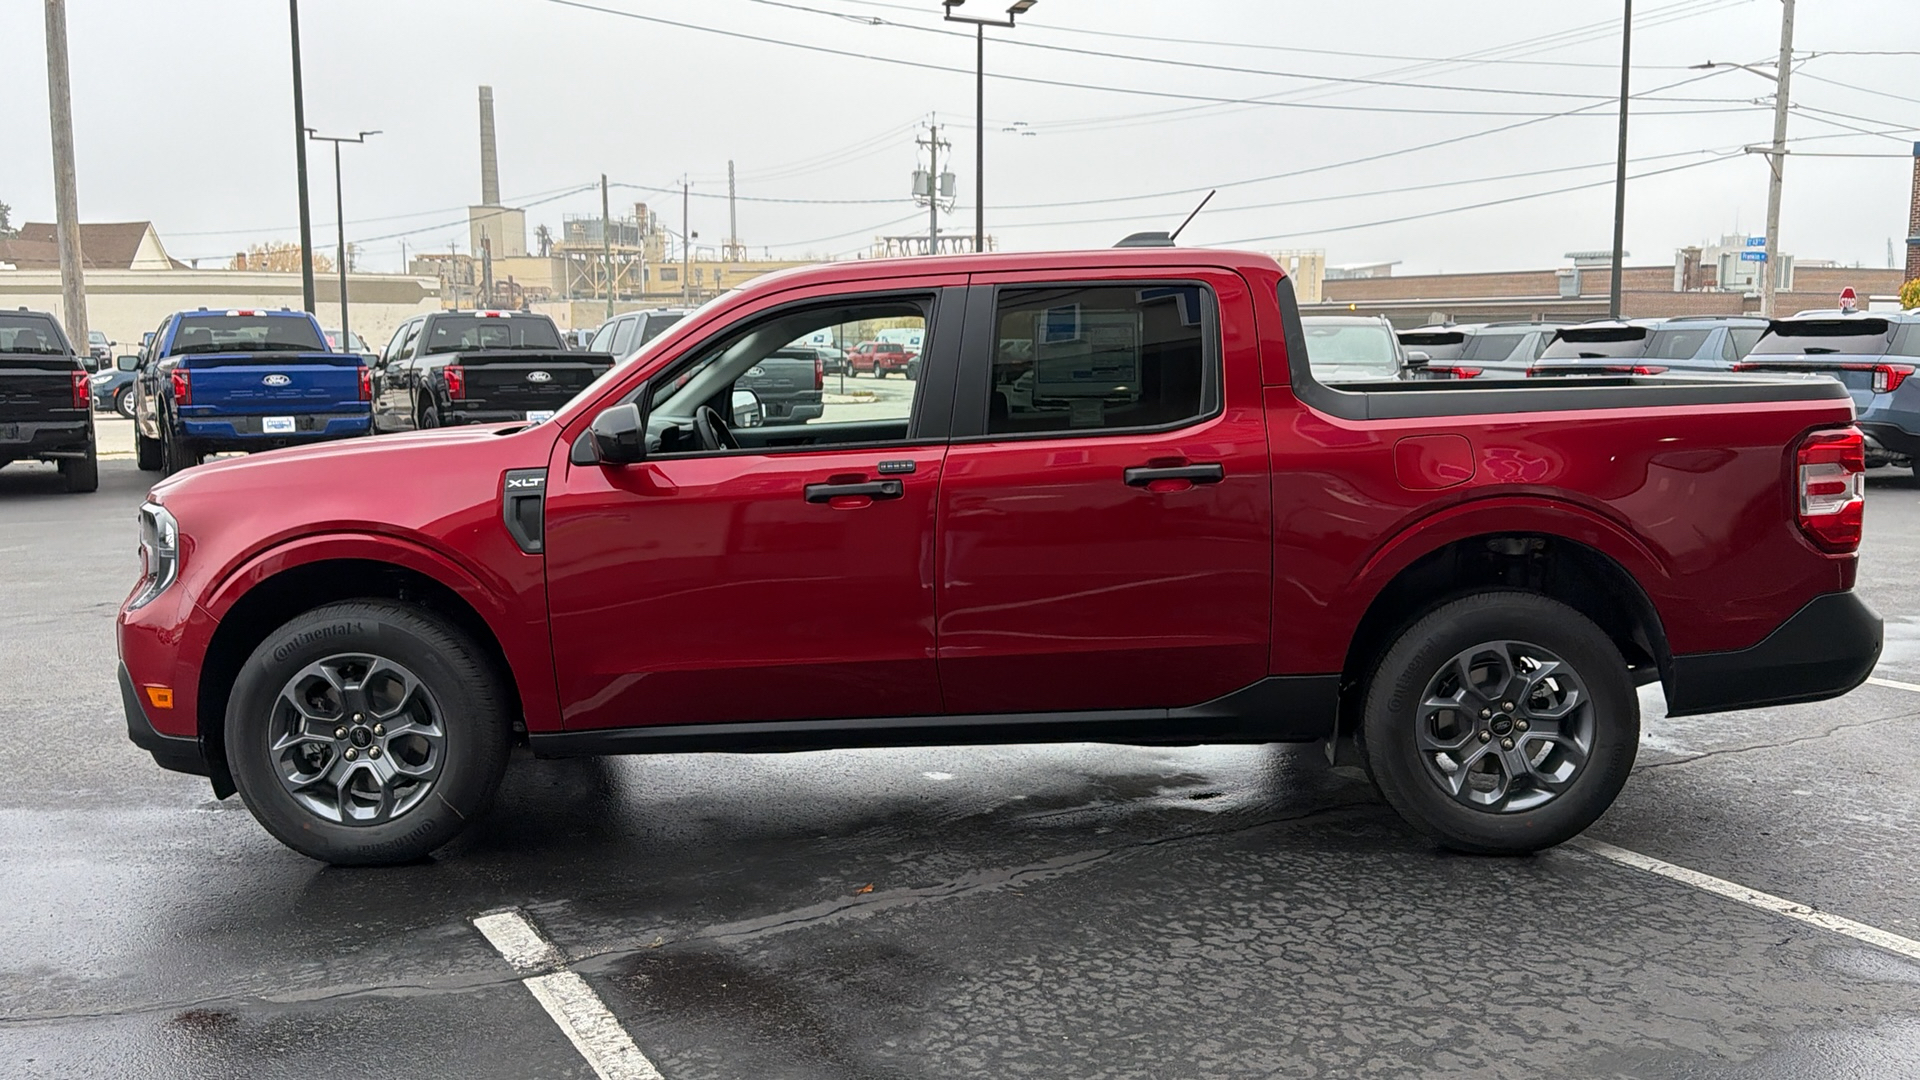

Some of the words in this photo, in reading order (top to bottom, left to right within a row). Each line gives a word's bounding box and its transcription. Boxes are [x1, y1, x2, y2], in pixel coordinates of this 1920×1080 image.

[1840, 297, 1856, 307] STOP
[265, 375, 289, 385] Ford
[529, 371, 550, 382] Ford
[508, 478, 545, 488] XLT
[273, 621, 353, 662] Continental
